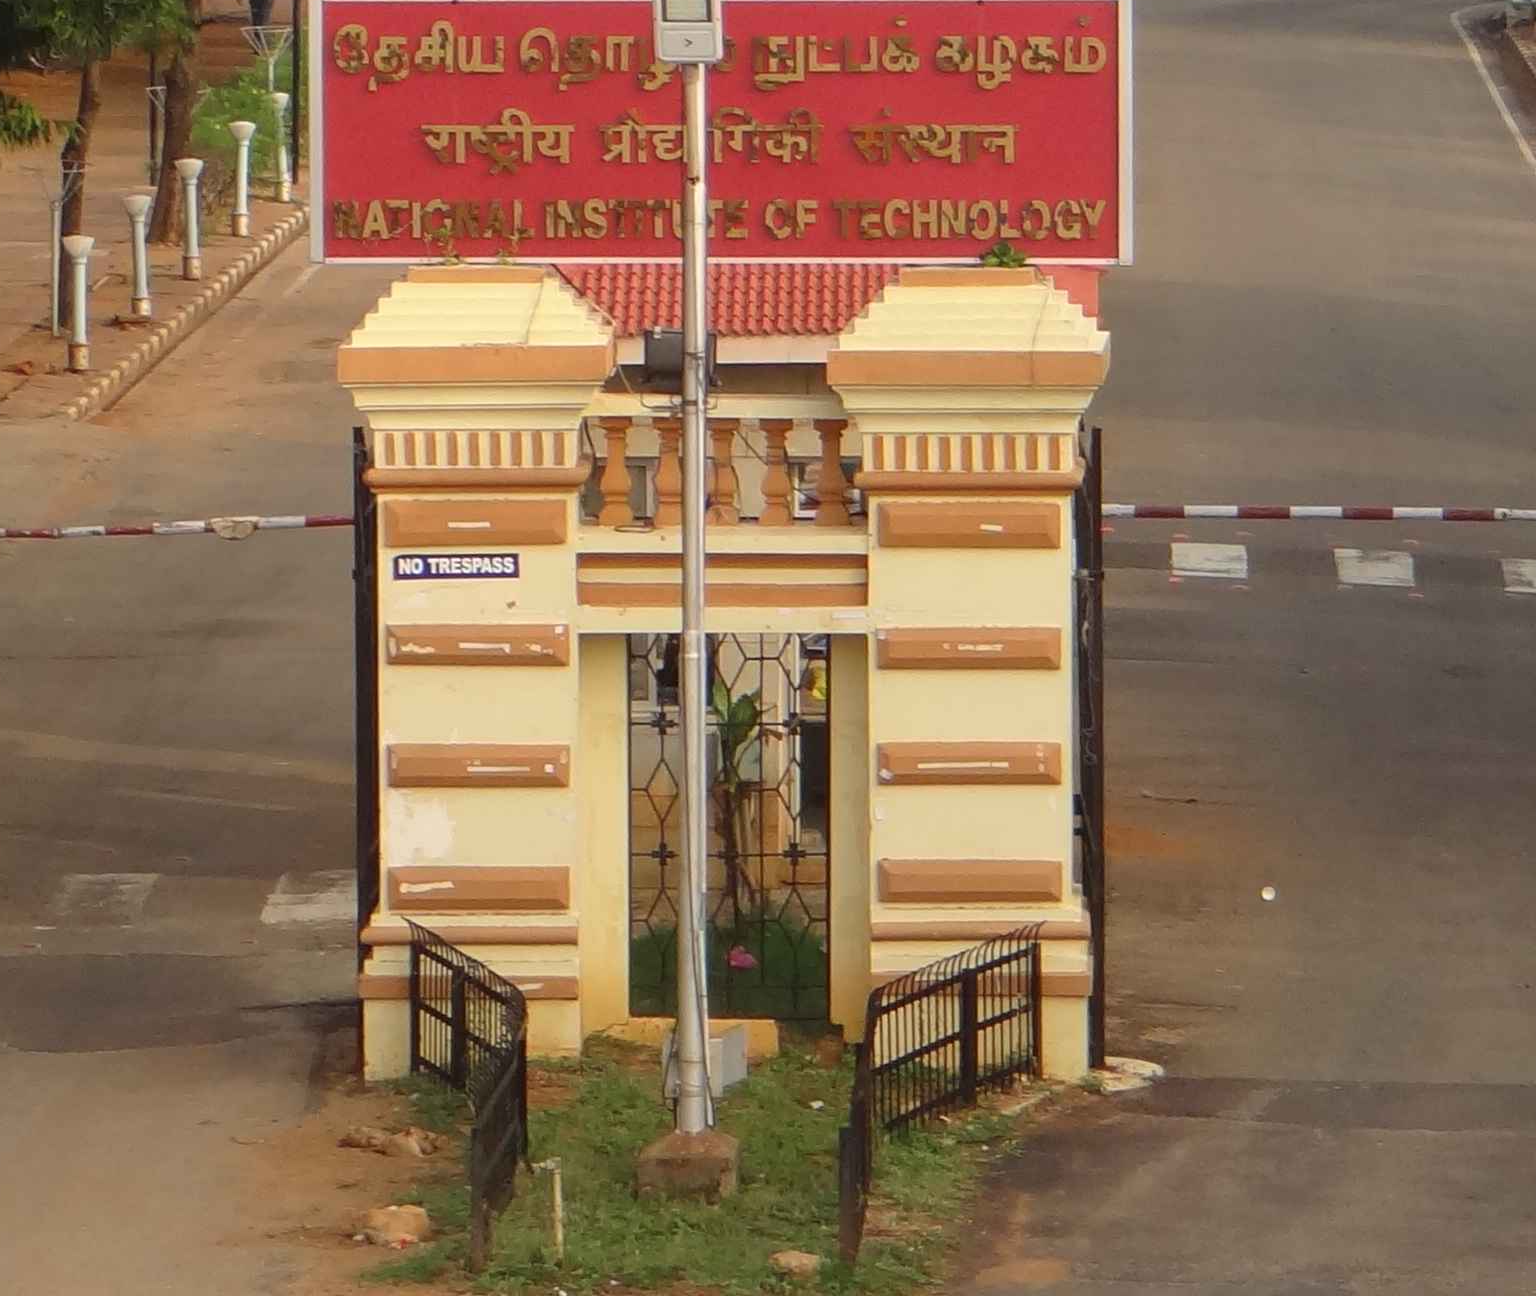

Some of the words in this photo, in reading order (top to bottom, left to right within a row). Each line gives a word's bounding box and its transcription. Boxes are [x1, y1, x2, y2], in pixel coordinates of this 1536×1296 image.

[333, 19, 504, 92] தேசிய
[519, 26, 737, 92] தொழ
[934, 14, 1107, 91] கழகம்
[421, 107, 576, 175] राष्ट्रीय
[599, 106, 823, 165] प्रौद्यगिकी
[847, 106, 1020, 165] संस्थान
[333, 198, 535, 241] NATIONAL
[763, 198, 819, 240] OF
[831, 198, 1107, 241] TECHNOLOGY
[398, 558, 424, 575] NO
[428, 557, 515, 575] TRESPASS
